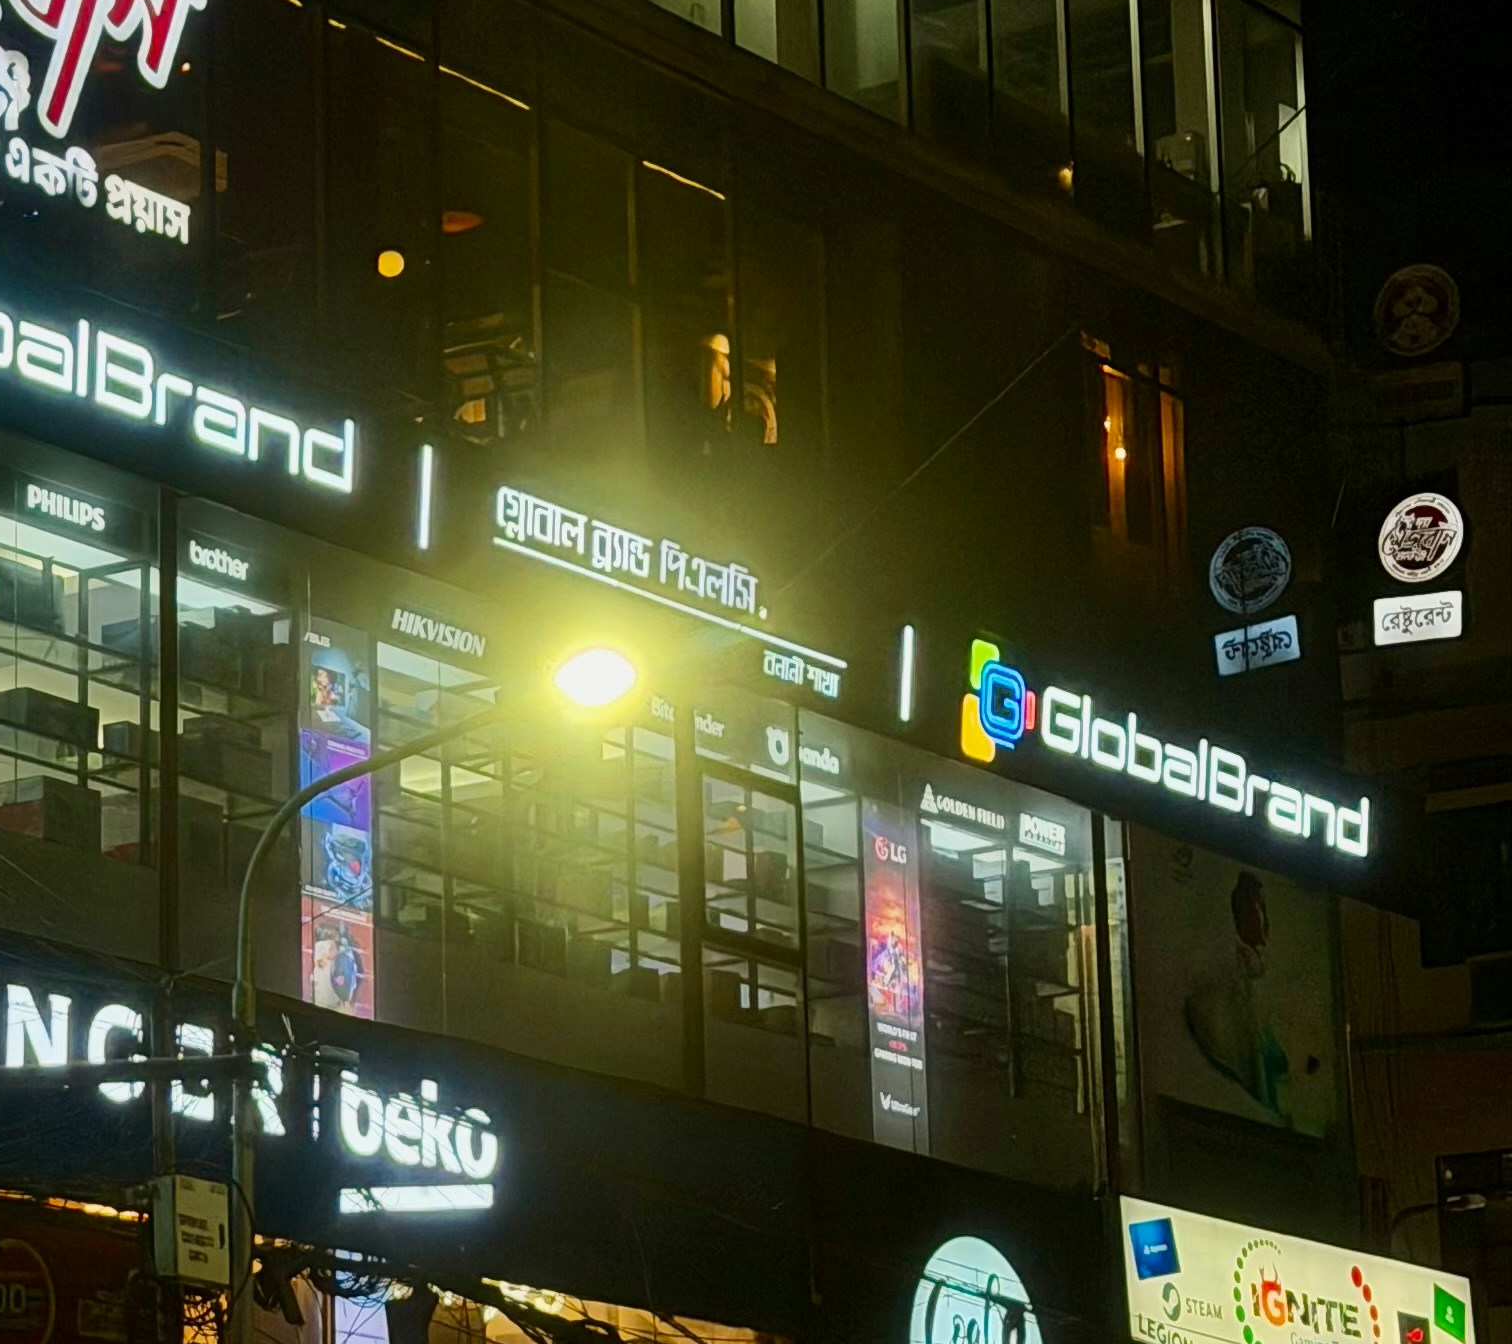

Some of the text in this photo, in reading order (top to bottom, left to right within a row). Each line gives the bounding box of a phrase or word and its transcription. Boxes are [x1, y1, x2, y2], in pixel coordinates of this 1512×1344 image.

[5, 137, 98, 209] একটি
[104, 173, 190, 244] প্রয়াস
[27, 483, 106, 532] PHILIPS
[496, 485, 587, 554] গ্লোবাল
[189, 539, 249, 582] brother
[392, 608, 486, 658] HIKVISION
[763, 649, 841, 698] বনানী শাখা
[1041, 685, 1371, 857] GlobalBrand
[936, 794, 1005, 829] GOLDEN FIELD
[890, 842, 907, 864] LG
[339, 1069, 499, 1179] beko
[1185, 1297, 1224, 1321] STEAM
[1250, 1278, 1363, 1338] IGNITE
